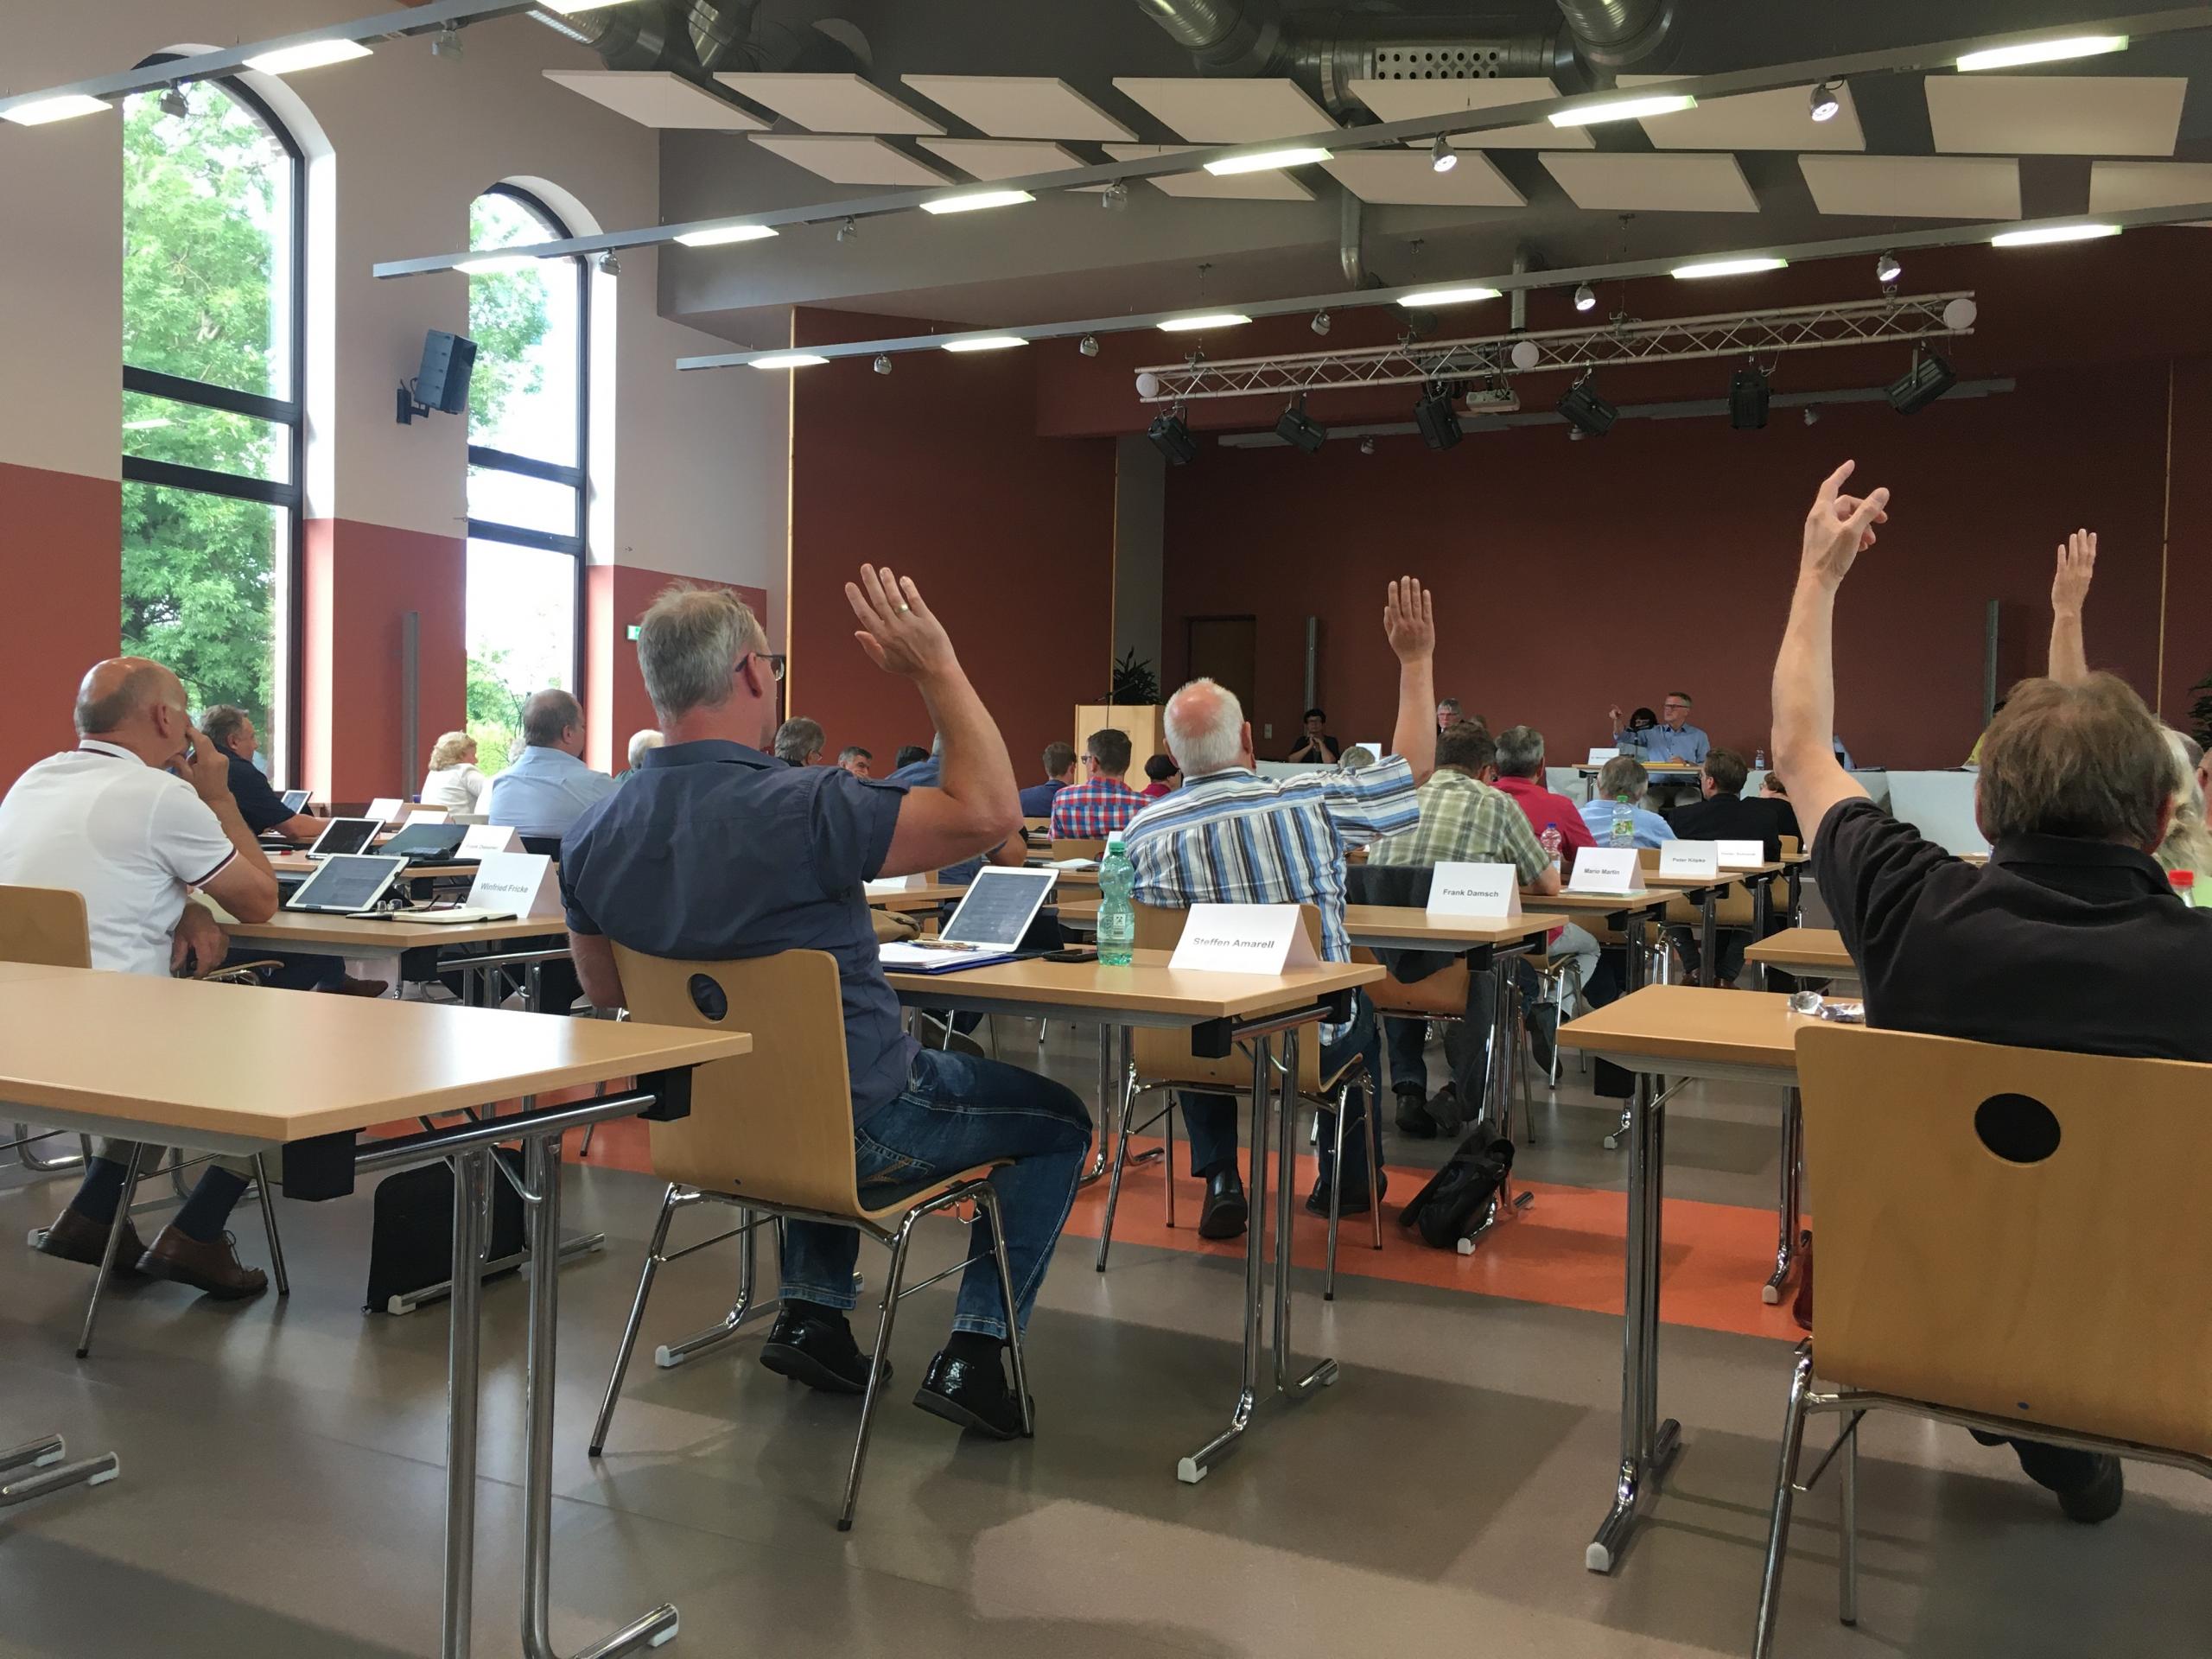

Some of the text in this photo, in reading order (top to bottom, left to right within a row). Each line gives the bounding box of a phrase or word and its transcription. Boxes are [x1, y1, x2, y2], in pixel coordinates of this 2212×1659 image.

[480, 882, 529, 893] Winfried Fricke
[1466, 889, 1499, 898] Damsch
[1193, 938, 1274, 949] Steffen Amarell
